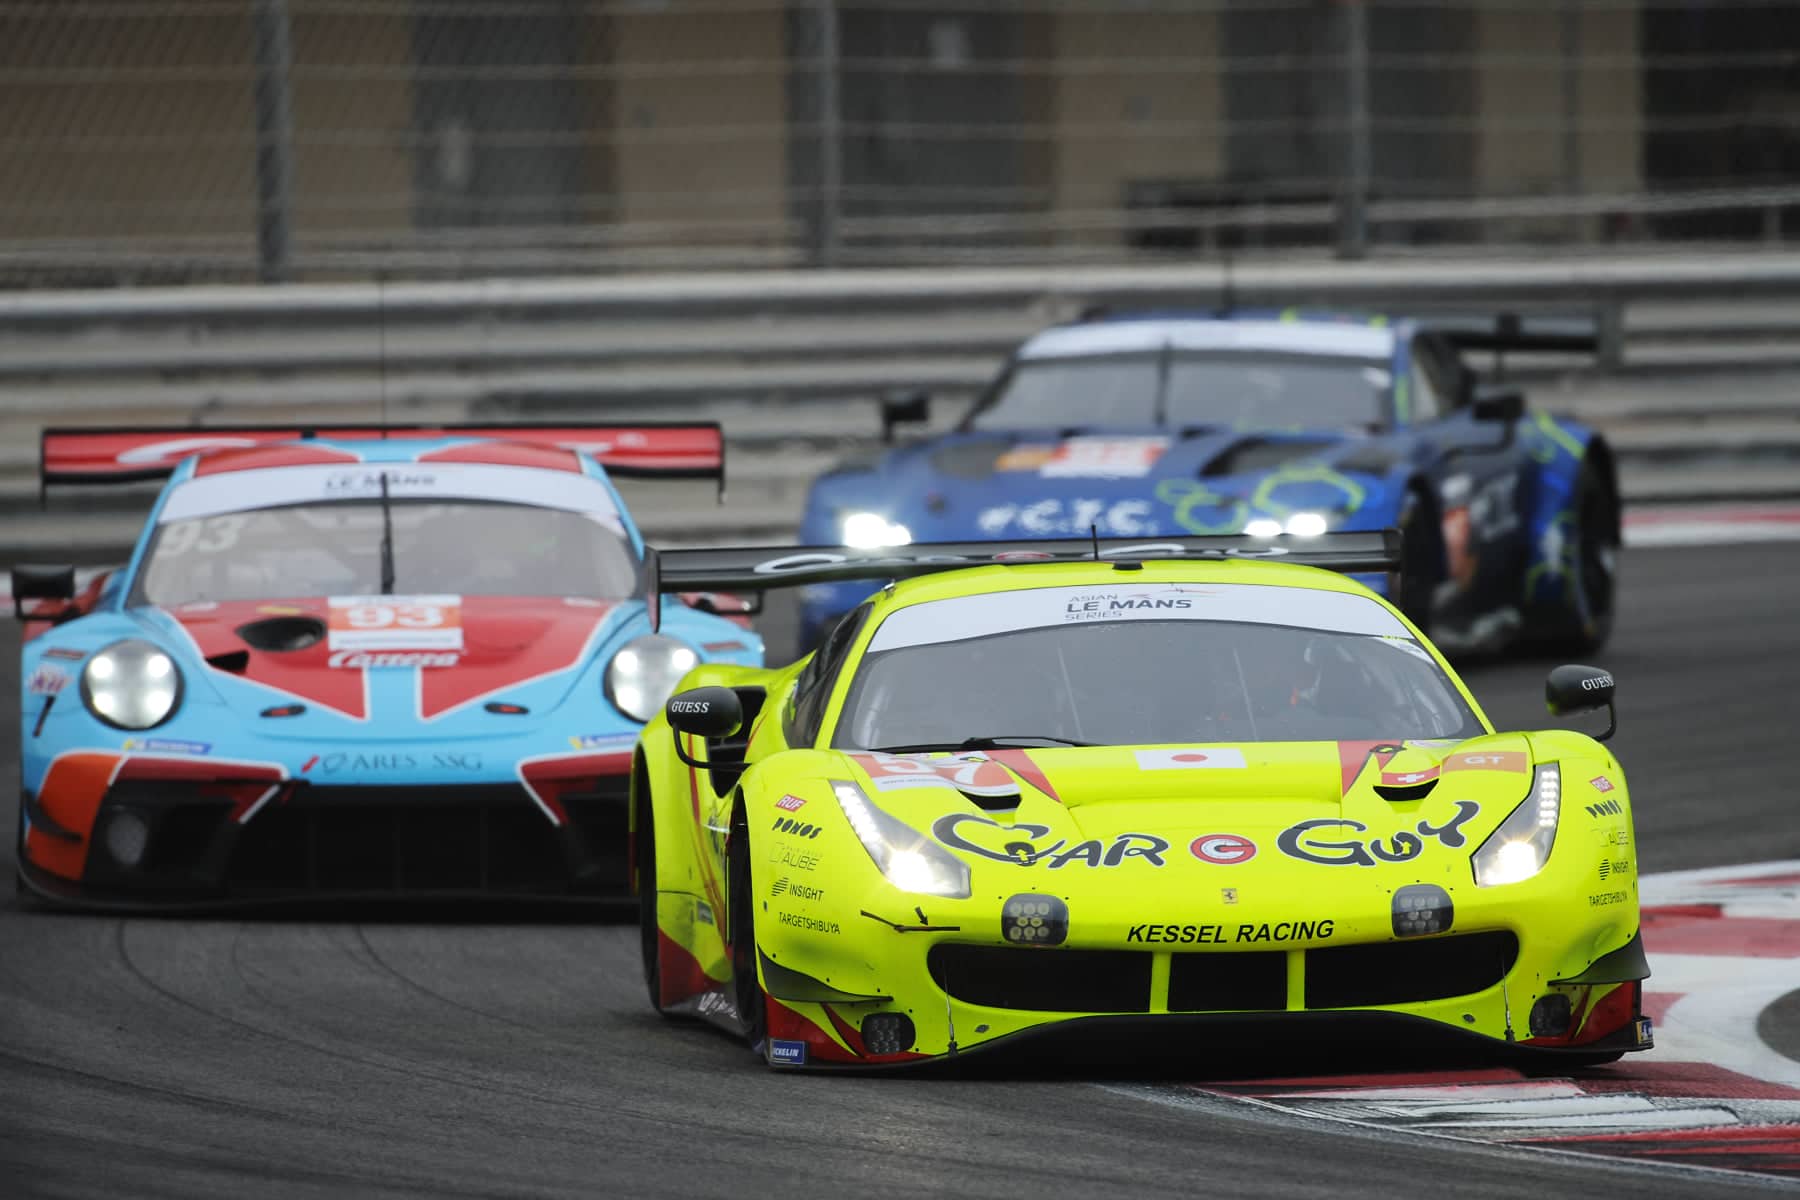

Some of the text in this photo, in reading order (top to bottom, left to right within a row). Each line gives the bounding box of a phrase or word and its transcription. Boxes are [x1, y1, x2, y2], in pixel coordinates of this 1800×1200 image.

[158, 520, 240, 556] 93
[1066, 599, 1193, 613] LE MANS
[1069, 593, 1118, 602] ASIAN
[348, 606, 444, 628] 93
[1064, 611, 1122, 621] SERIES
[1582, 676, 1614, 691] GUESS
[671, 700, 710, 713] GUESS
[351, 753, 418, 770] ARES
[1464, 755, 1505, 765] GT
[777, 795, 806, 811] RUF
[772, 816, 823, 839] PONOS
[782, 852, 820, 872] AUBE
[789, 884, 824, 901] INSIGHT
[779, 911, 841, 935] TARGETSHIBUYA
[1126, 919, 1336, 944] KESSEL RACING
